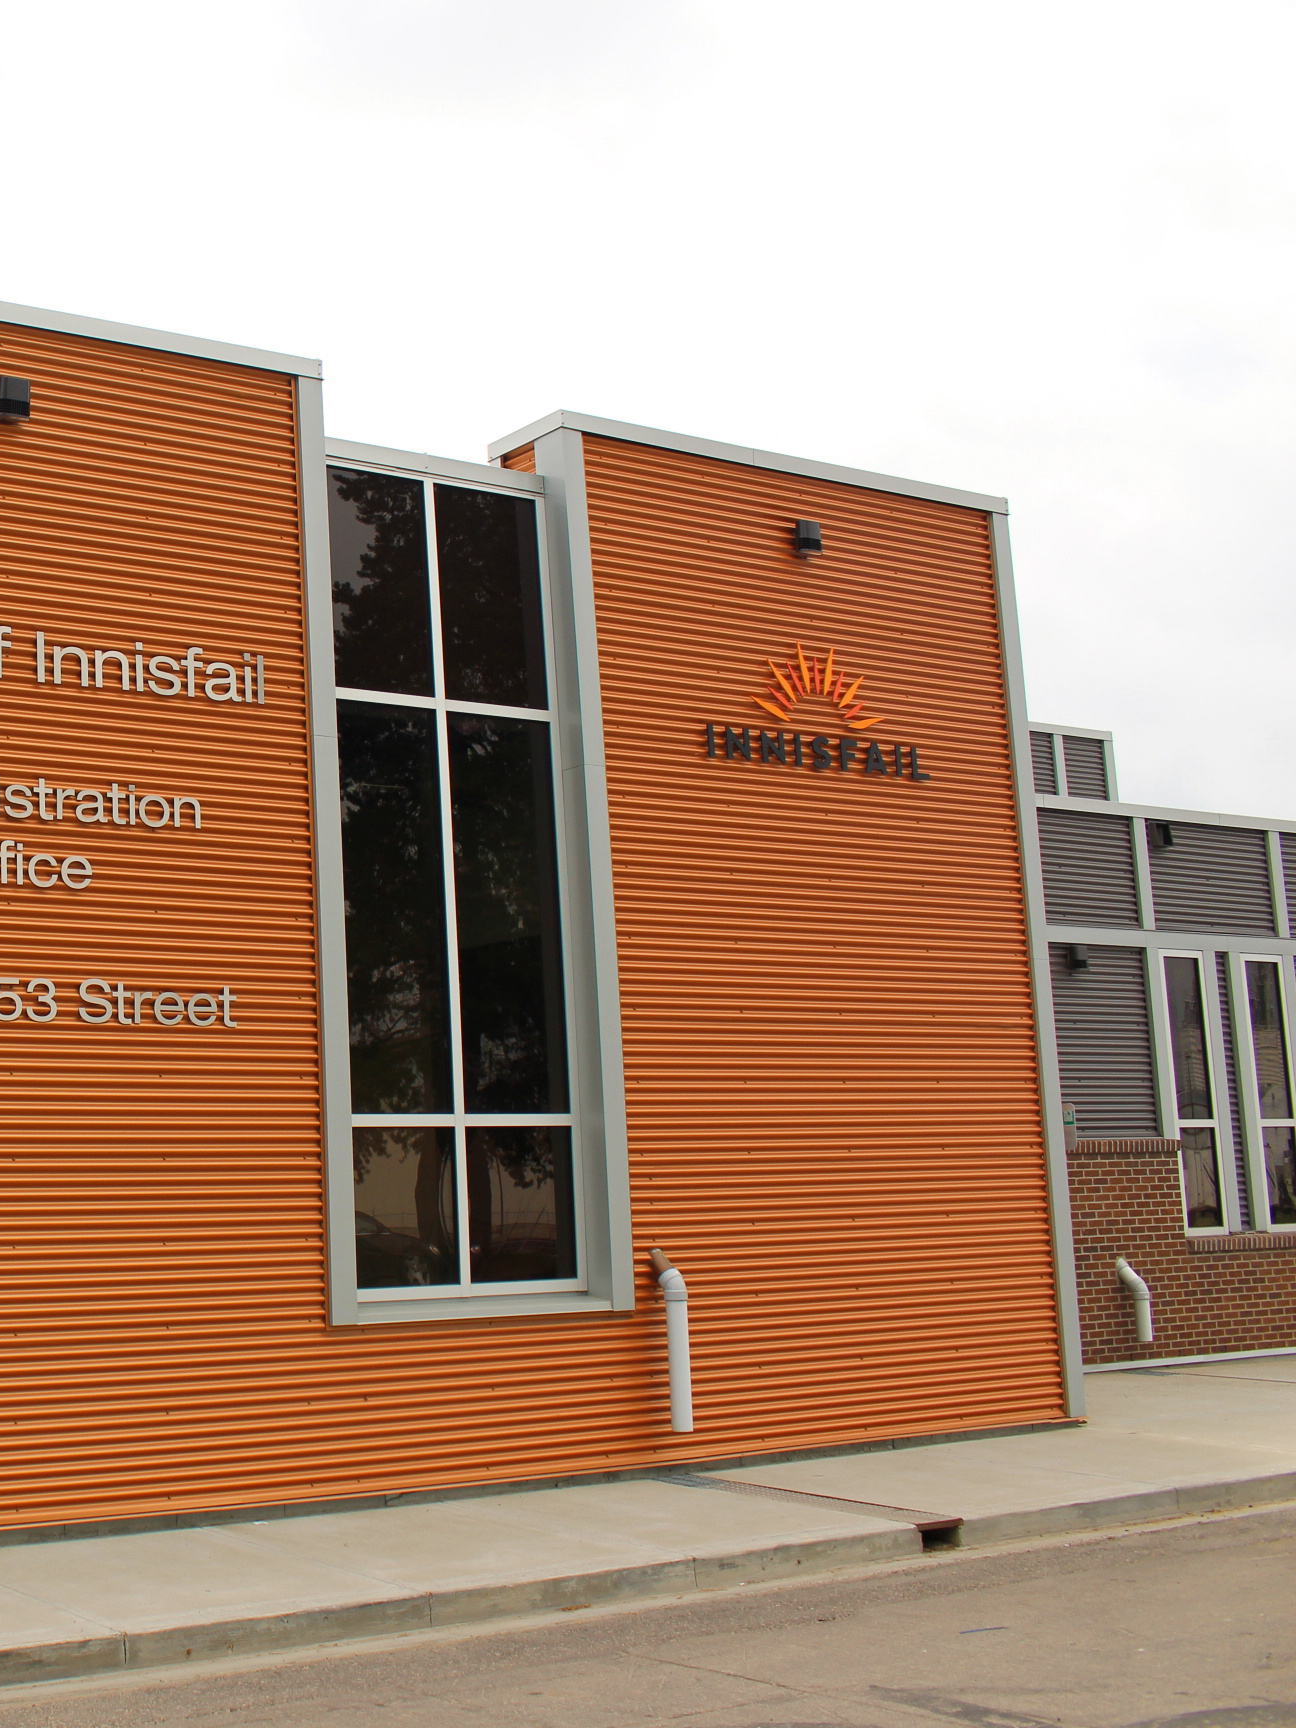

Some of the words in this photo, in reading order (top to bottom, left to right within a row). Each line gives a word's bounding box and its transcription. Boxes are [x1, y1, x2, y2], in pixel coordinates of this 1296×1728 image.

[36, 631, 265, 704] Innisfail
[706, 724, 930, 780] INNISFAIL
[78, 979, 238, 1027] Street
